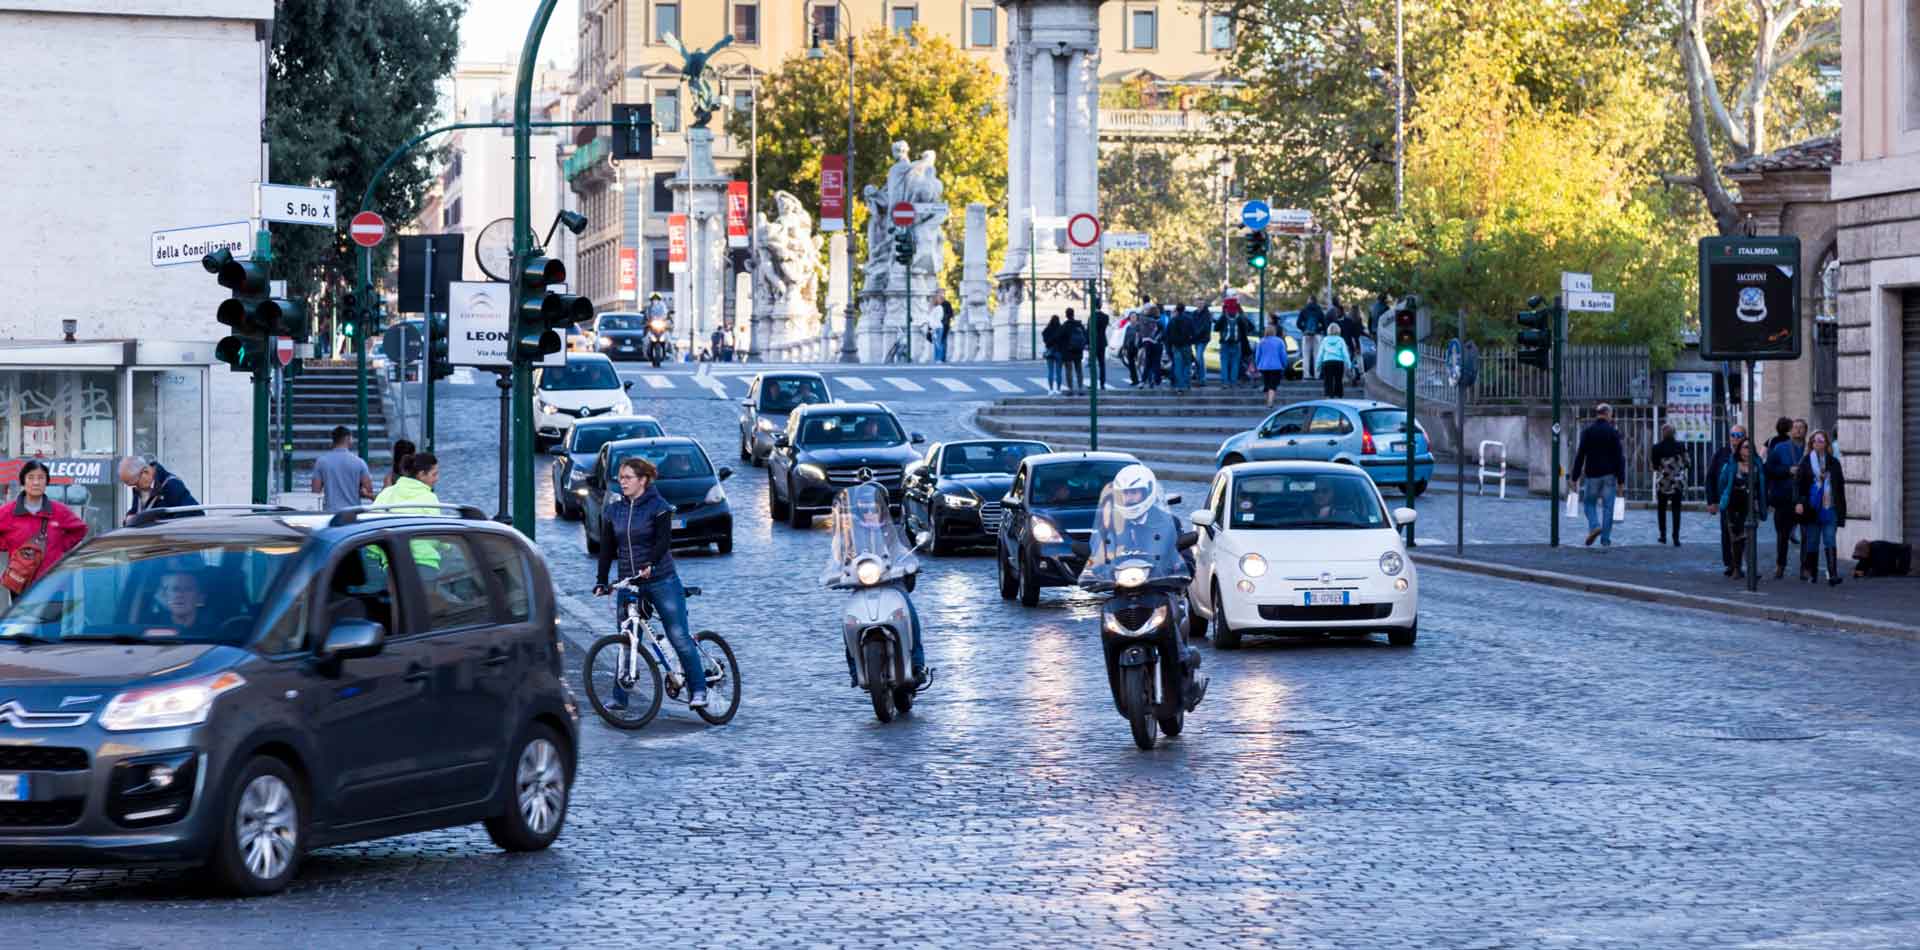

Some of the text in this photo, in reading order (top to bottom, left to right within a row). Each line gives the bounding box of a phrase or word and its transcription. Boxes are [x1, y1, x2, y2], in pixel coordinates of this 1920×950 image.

[287, 202, 330, 218] S. Pio X
[156, 245, 179, 259] della
[1738, 247, 1779, 255] ITALMEDIA
[466, 331, 509, 341] LEON
[43, 462, 101, 476] LECOM
